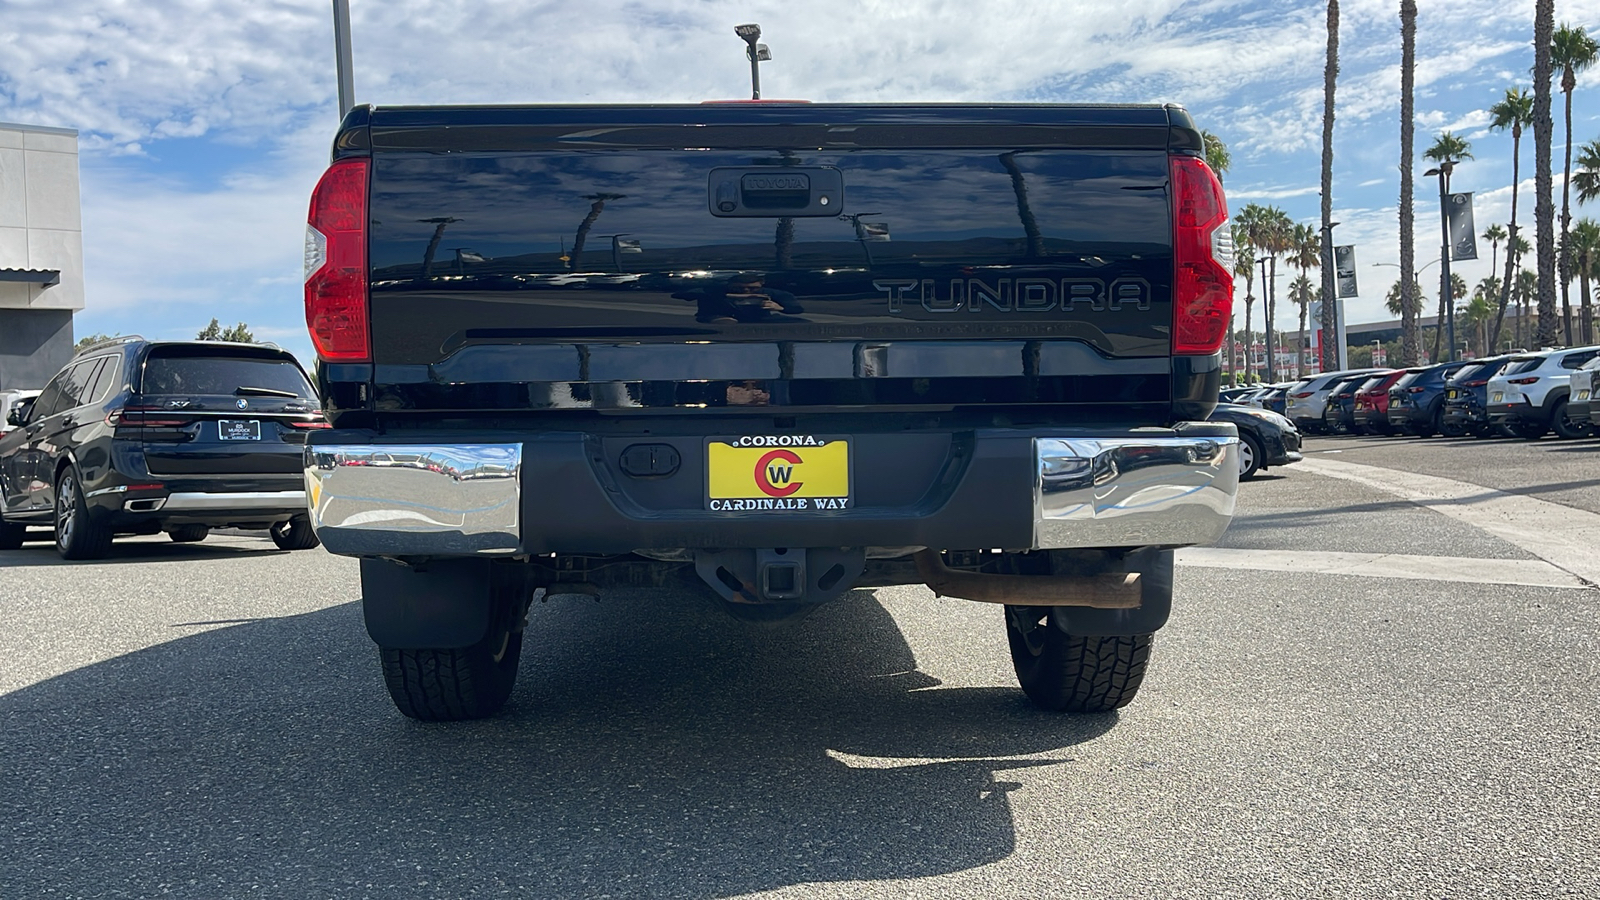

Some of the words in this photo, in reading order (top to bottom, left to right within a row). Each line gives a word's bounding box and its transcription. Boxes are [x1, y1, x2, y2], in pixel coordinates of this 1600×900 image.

[748, 177, 806, 189] TOYOTA
[872, 277, 1151, 312] TUNDRA
[739, 435, 817, 447] CORONA
[709, 499, 808, 511] CARDINALE
[813, 498, 849, 510] WAY
